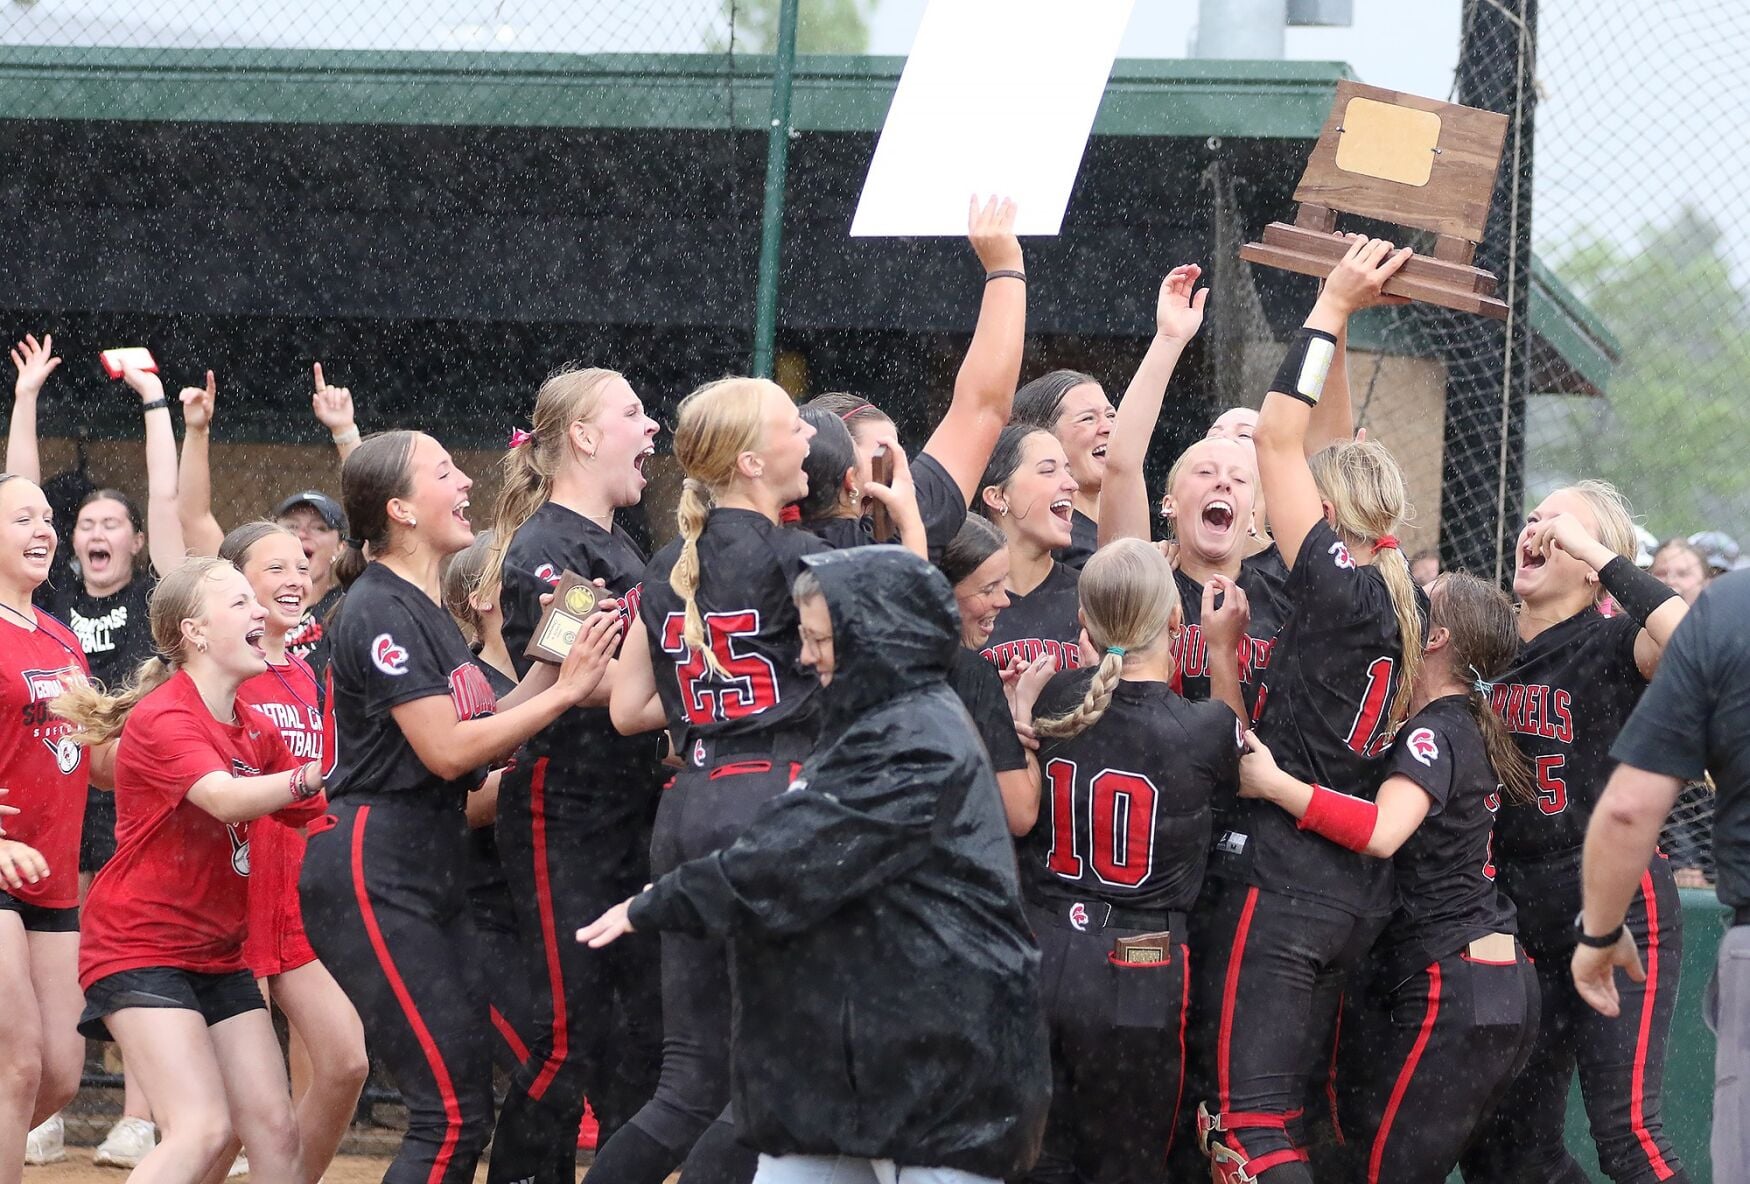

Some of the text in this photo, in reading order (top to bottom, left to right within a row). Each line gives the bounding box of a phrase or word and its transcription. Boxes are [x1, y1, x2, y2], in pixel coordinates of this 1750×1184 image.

[661, 609, 780, 724] 25
[1046, 757, 1158, 888] 10
[1535, 753, 1568, 815] 5
